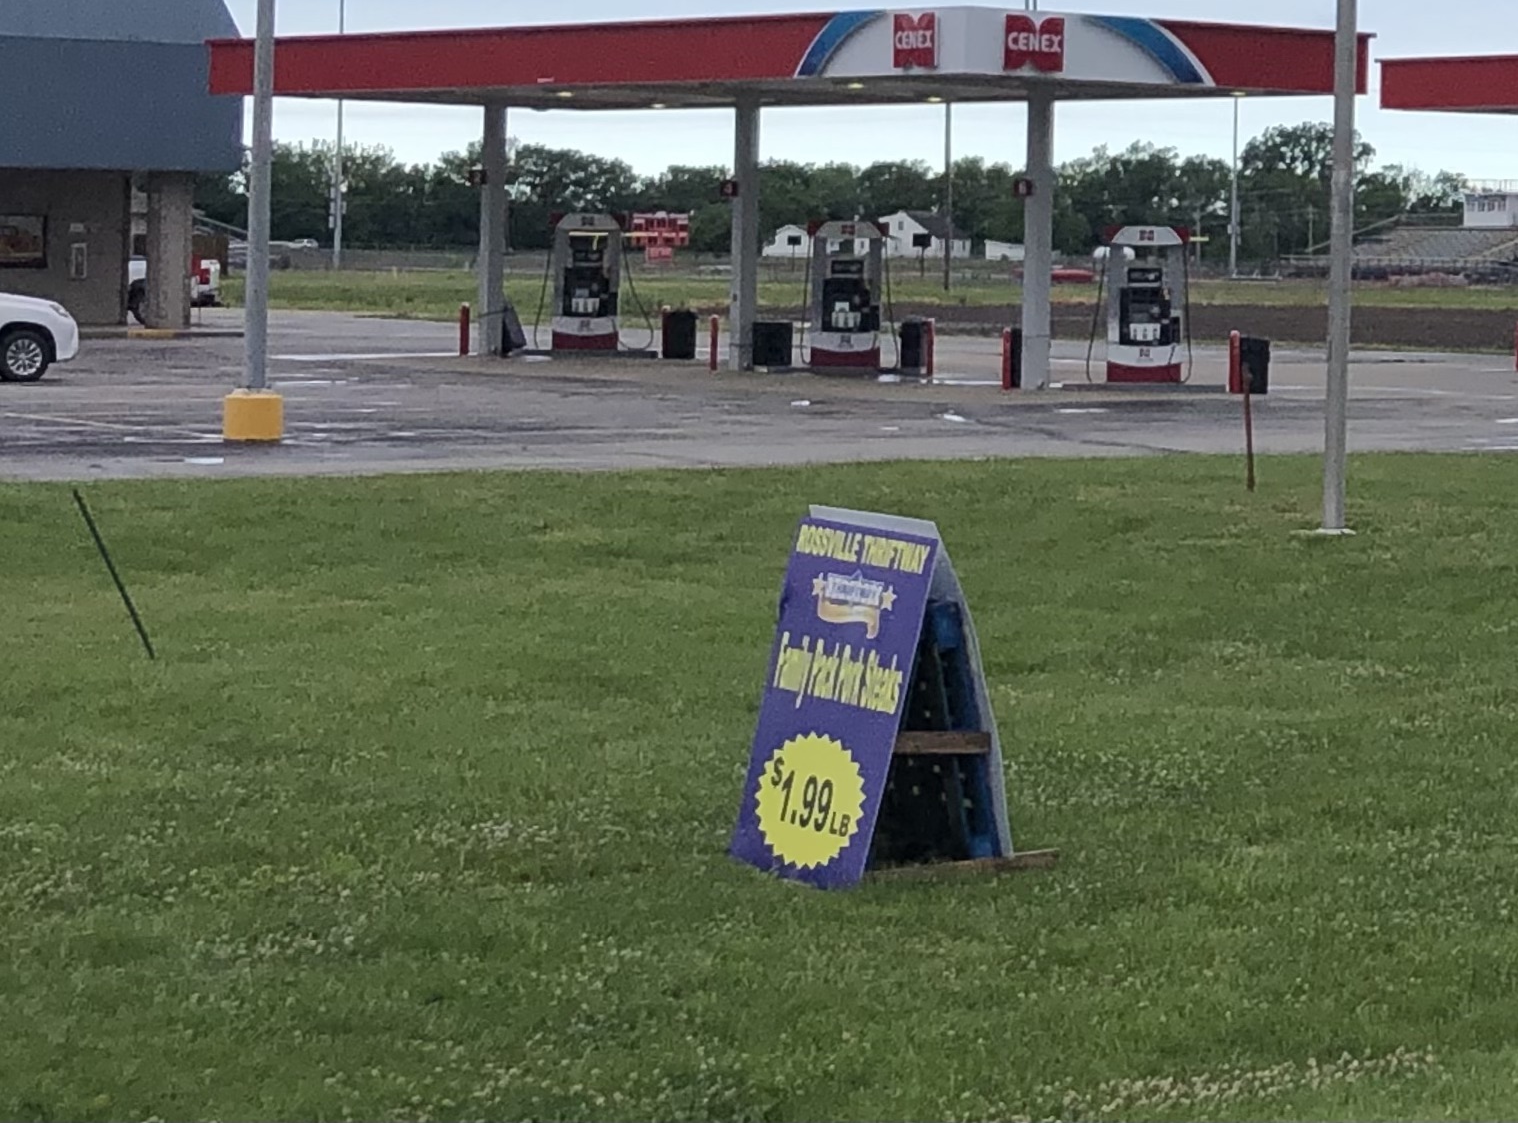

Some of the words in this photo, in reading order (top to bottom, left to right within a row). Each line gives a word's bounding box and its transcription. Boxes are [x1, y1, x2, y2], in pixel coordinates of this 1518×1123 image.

[895, 30, 933, 50] CENEX
[1007, 31, 1062, 53] CENEX
[796, 524, 863, 563] ROSSVILLE
[829, 811, 851, 837] LB
